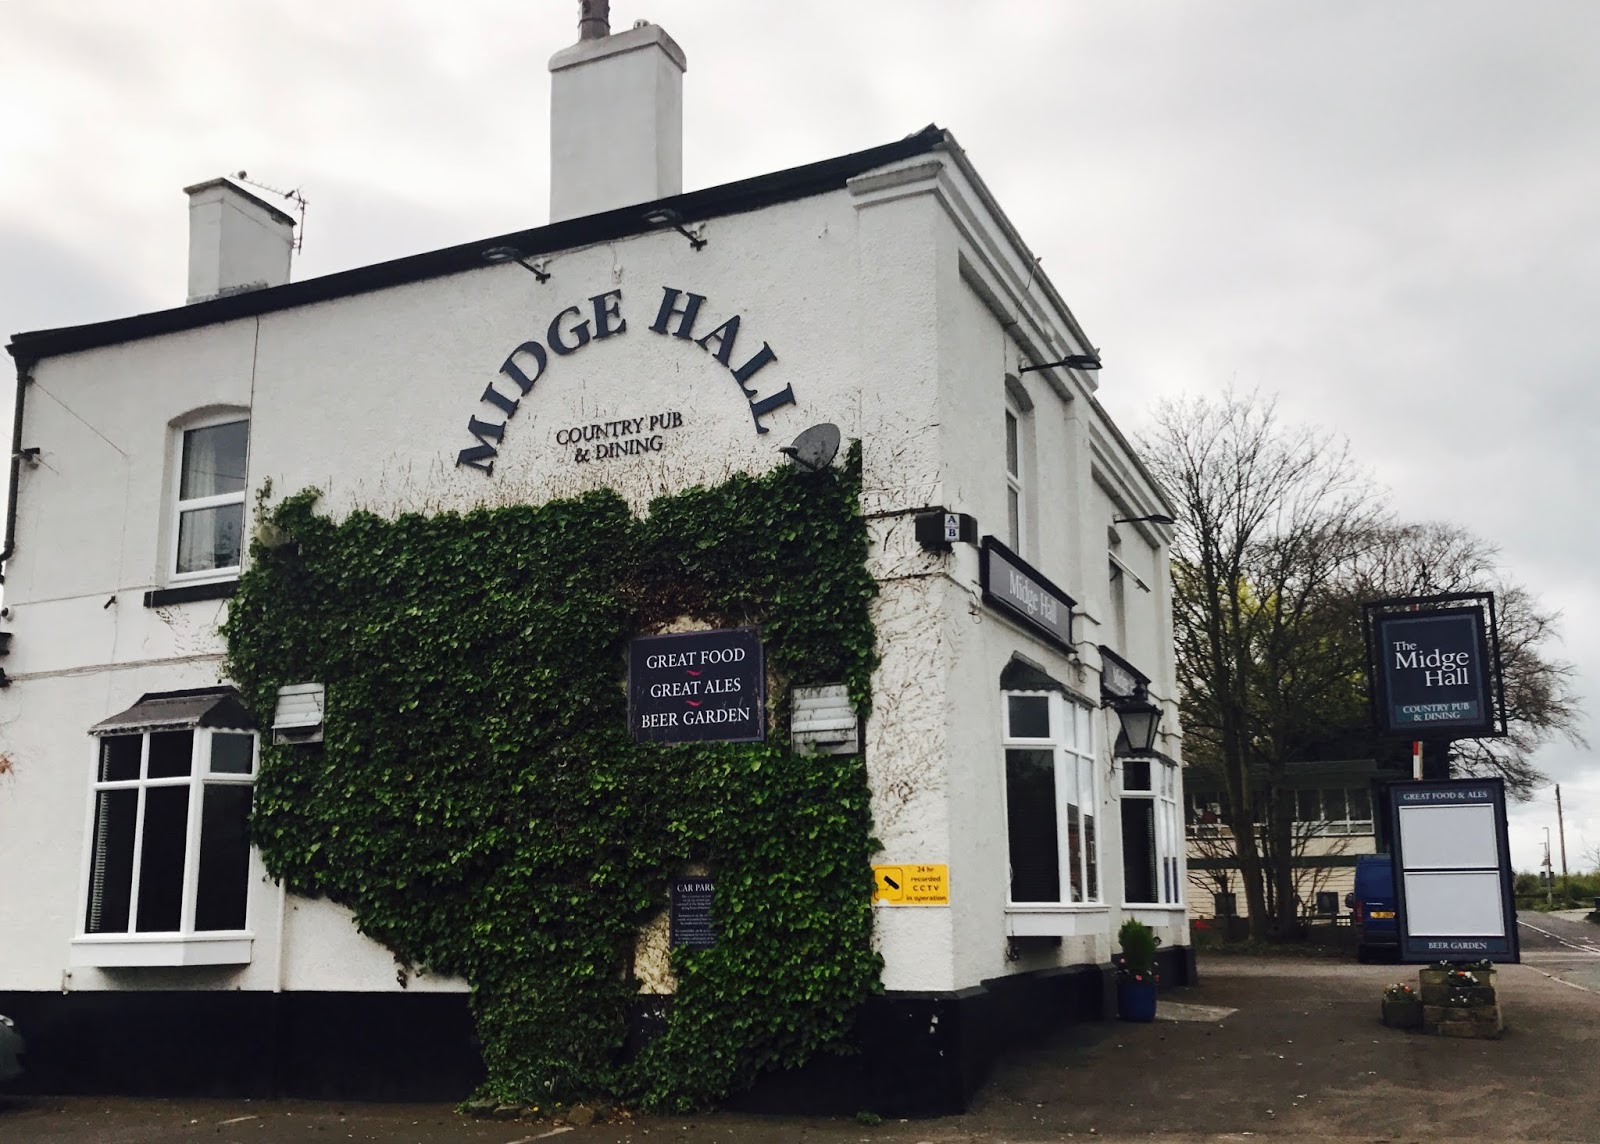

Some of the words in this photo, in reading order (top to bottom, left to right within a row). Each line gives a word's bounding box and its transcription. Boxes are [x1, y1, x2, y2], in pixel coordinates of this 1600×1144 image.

[455, 288, 627, 477] MIDGE
[648, 286, 797, 434] HALL
[556, 417, 645, 445] COUNTRY
[649, 411, 683, 431] PUB
[574, 447, 590, 463] &
[595, 435, 664, 460] DINING
[947, 515, 957, 524] A
[948, 528, 956, 537] B
[1009, 570, 1039, 615] Midge
[1040, 592, 1058, 625] Hall
[1393, 641, 1417, 651] The
[646, 652, 697, 669] GREAT
[700, 647, 746, 665] FOOD
[1395, 649, 1470, 672] Midge
[1425, 668, 1469, 687] Hall
[650, 680, 701, 698] GREAT
[704, 677, 741, 694] ALES
[1403, 704, 1449, 713] COUNTRY
[1451, 702, 1470, 711] PUB
[1424, 712, 1460, 720] DINING
[641, 712, 679, 729] BEER
[683, 707, 750, 726] GARDEN
[1403, 792, 1430, 801] GREAT
[1432, 791, 1456, 800] FOOD
[1467, 791, 1488, 799] ALES
[677, 884, 693, 892] CAR
[1428, 941, 1449, 950] BEER
[1450, 940, 1487, 950] GARDEN
